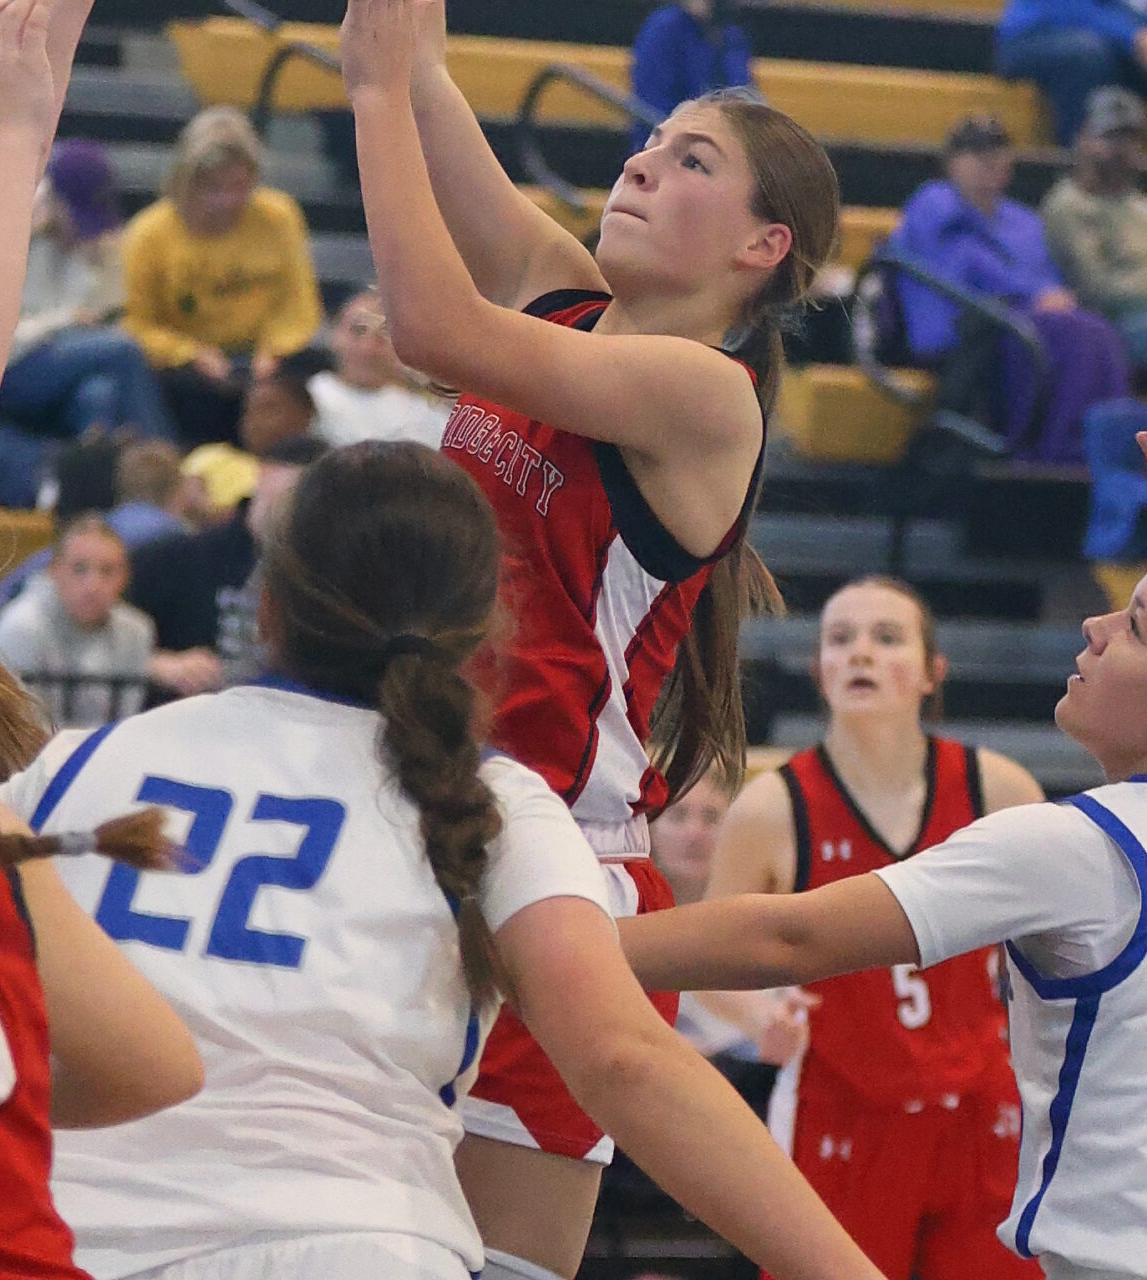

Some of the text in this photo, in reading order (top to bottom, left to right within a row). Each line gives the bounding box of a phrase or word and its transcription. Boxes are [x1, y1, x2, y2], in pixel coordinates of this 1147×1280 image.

[494, 430, 565, 517] CITY
[93, 773, 349, 970] 22
[890, 962, 932, 1030] 5
